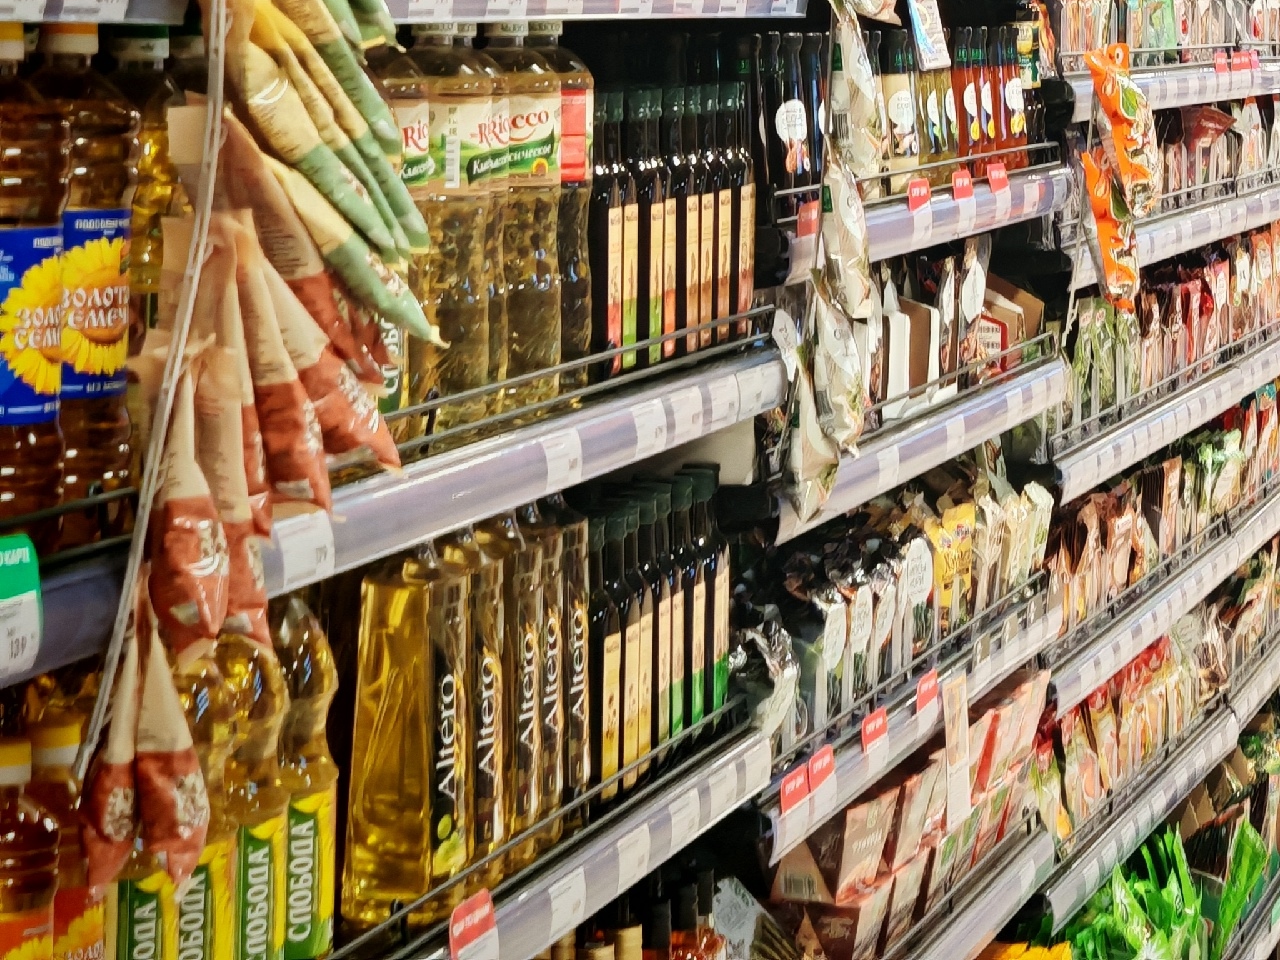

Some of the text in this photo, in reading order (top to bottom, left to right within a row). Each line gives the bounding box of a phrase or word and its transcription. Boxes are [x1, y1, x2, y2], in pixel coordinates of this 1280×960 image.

[402, 119, 428, 152] Ric
[477, 656, 495, 779] Altero
[519, 632, 535, 752] Altero
[543, 616, 559, 734] Altero
[570, 607, 586, 723] Altero
[436, 673, 456, 800] Altero
[132, 897, 158, 960] ОДА
[245, 844, 271, 960] ЛОБОДА
[287, 817, 315, 943] СЛОБОДА
